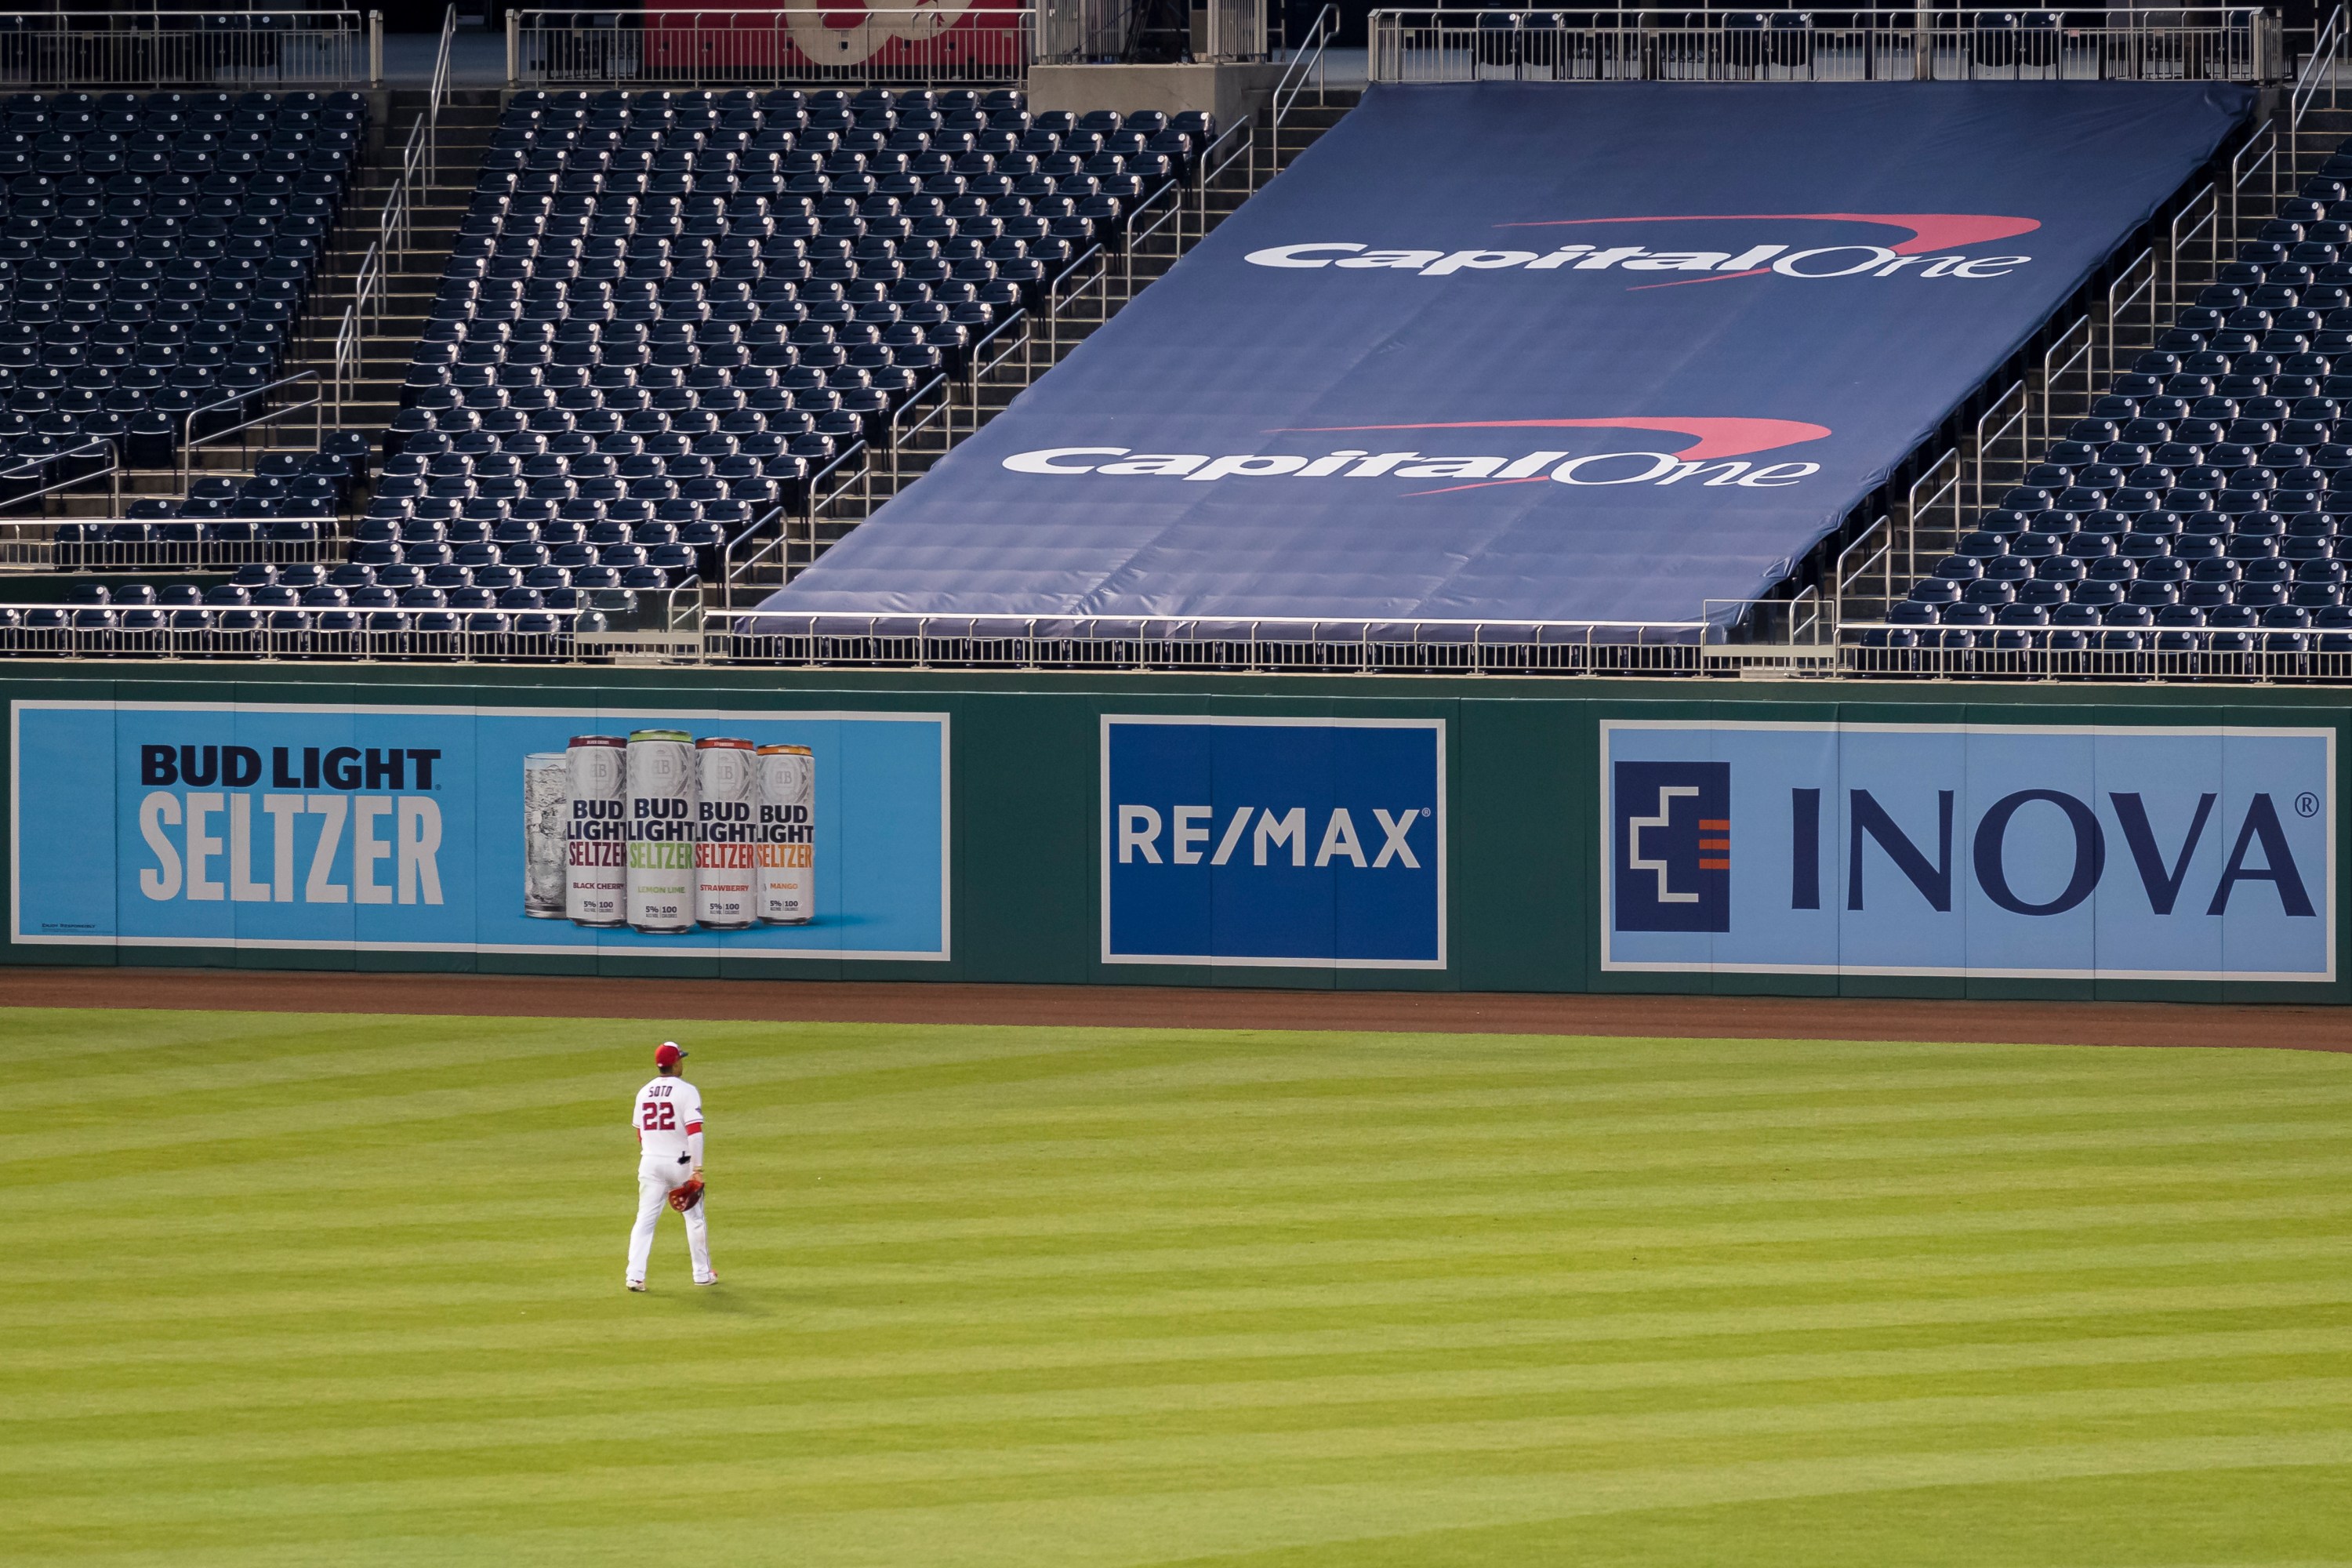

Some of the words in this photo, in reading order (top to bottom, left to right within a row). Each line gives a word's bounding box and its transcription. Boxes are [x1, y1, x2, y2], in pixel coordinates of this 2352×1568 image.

[141, 744, 262, 787] BUD
[573, 800, 624, 820] BUD
[634, 798, 688, 819] BUD
[699, 801, 750, 822] BUD
[760, 804, 808, 824] BUD
[627, 819, 695, 842] LIGHT
[139, 790, 445, 905] SELTZER
[569, 841, 627, 867] SELTZER
[630, 842, 693, 869] SELTZER
[695, 843, 754, 869] SELTZER
[757, 844, 812, 868] SELTZER
[648, 1085, 673, 1098] SOTO
[642, 1102, 676, 1131] 22
